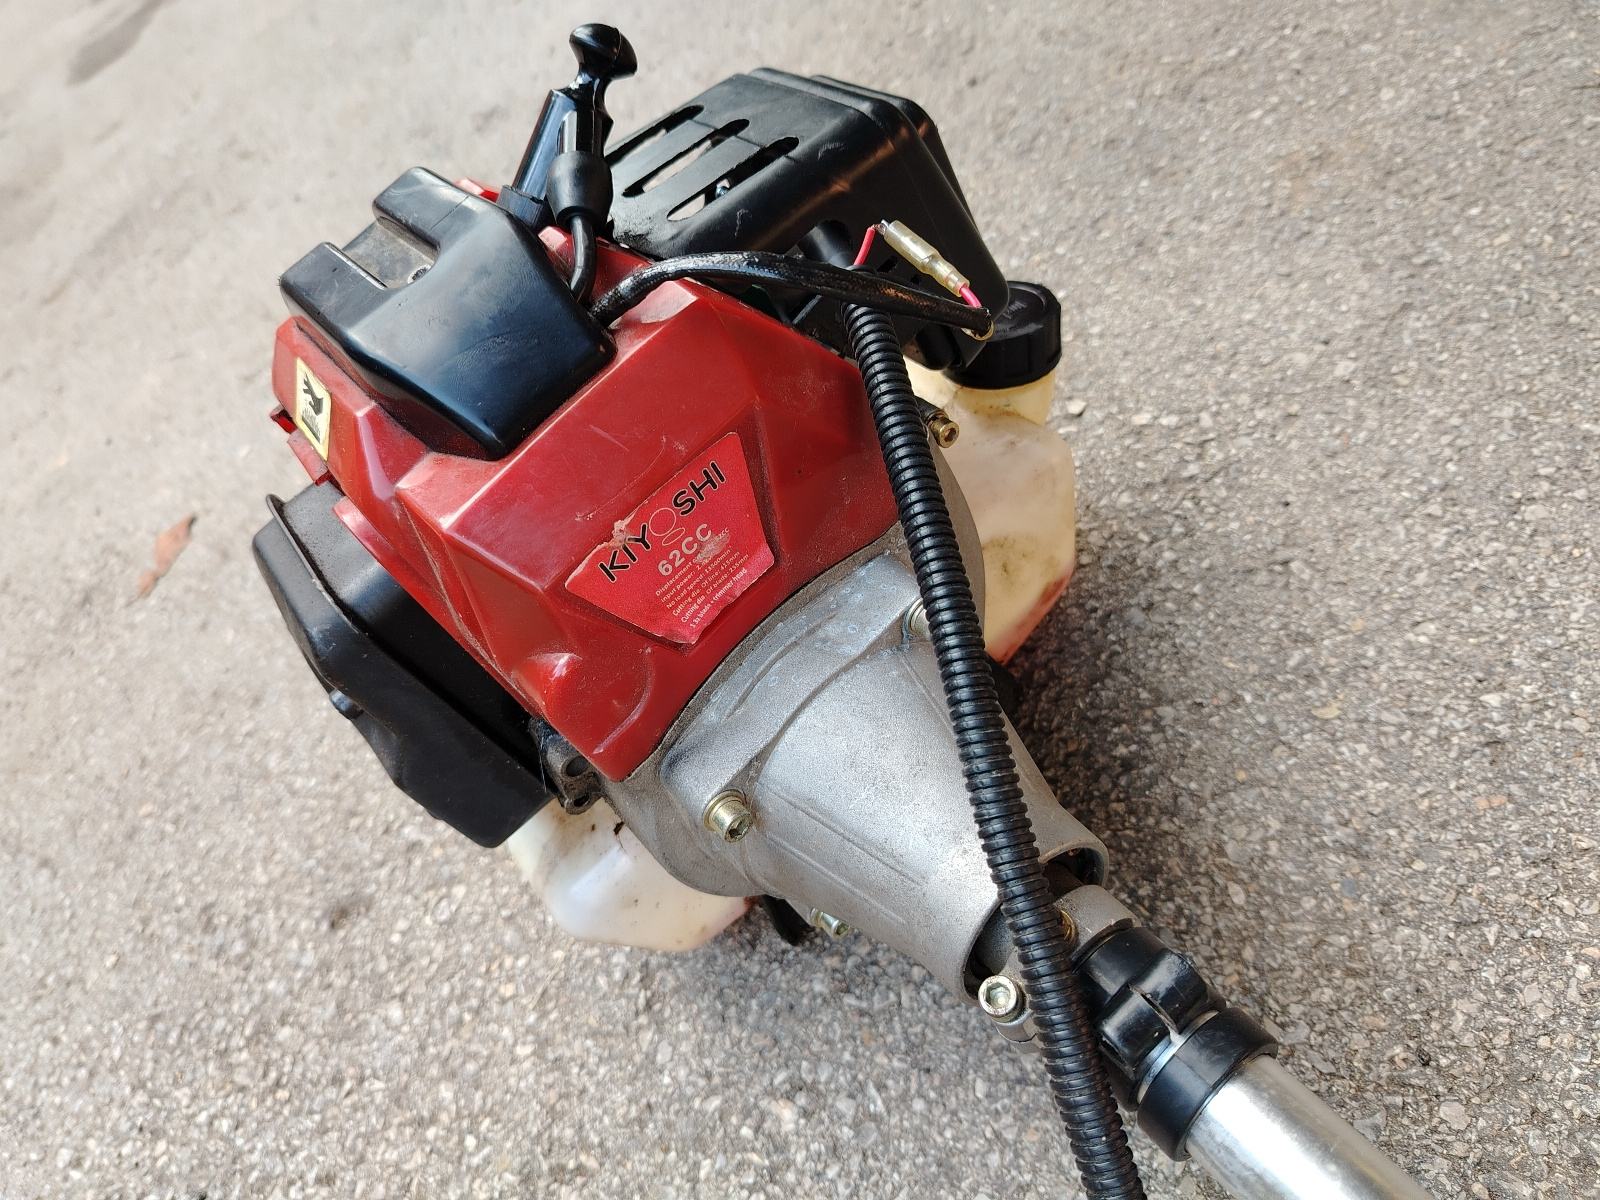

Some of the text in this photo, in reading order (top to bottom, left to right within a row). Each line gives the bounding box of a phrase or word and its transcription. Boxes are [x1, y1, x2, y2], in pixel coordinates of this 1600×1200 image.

[598, 460, 727, 583] KIYOSHI
[658, 523, 712, 577] 62CC
[655, 561, 692, 597] Displacement
[659, 588, 676, 603] Input
[666, 600, 676, 610] No
[675, 588, 688, 602] load
[686, 573, 705, 591] speed:
[672, 596, 693, 616] Cutting
[701, 580, 709, 588] Of
[708, 569, 720, 581] line:
[681, 603, 700, 623] Cutting
[706, 585, 714, 594] Of
[713, 571, 730, 588] blade:
[712, 580, 734, 601] trimmer
[731, 567, 748, 583] head
